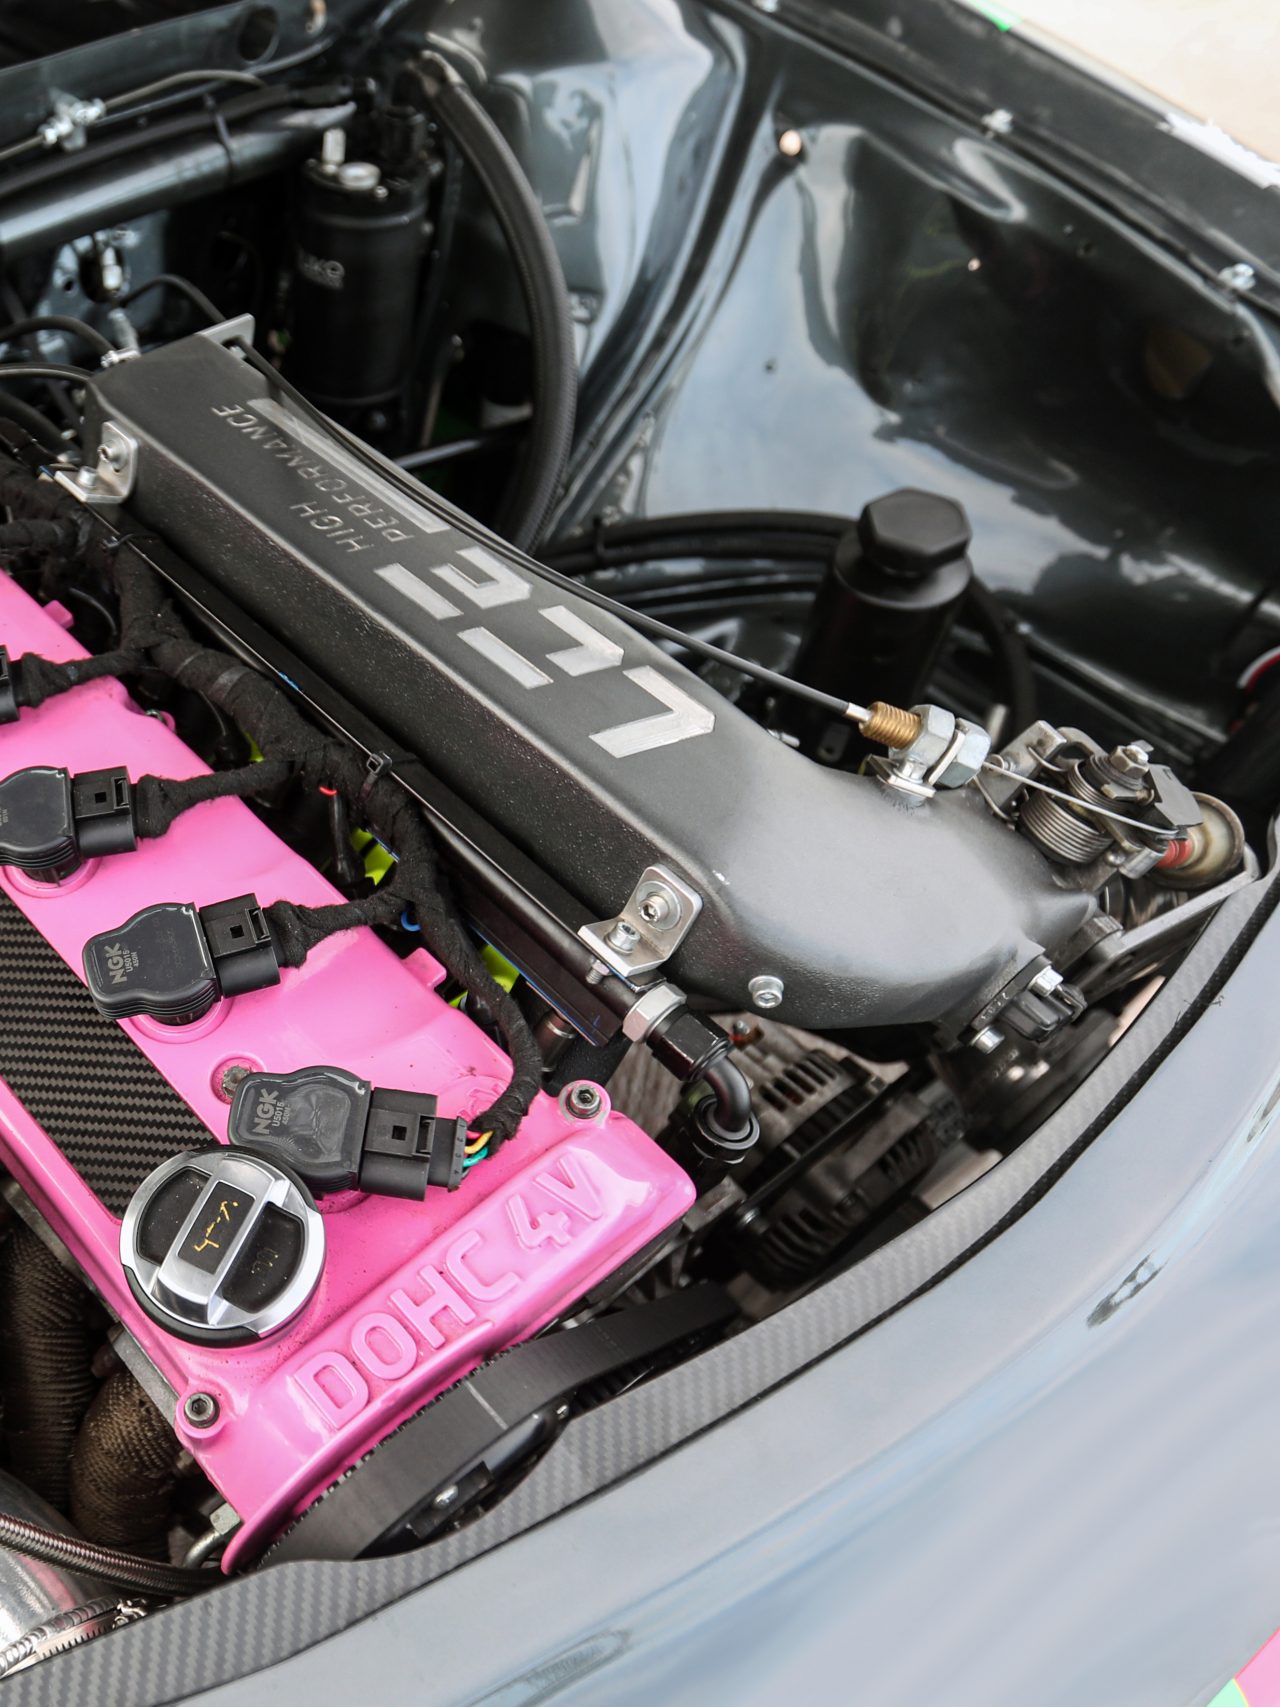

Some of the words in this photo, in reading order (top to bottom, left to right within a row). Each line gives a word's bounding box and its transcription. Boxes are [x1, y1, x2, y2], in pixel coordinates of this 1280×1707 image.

[210, 403, 415, 543] PERFORMANCE
[289, 501, 374, 553] HIGH
[103, 943, 128, 985] NGK
[122, 950, 134, 973] U5015
[252, 1088, 280, 1135] NGK
[272, 1101, 285, 1127] U5015
[286, 1229, 521, 1431] DOHC
[505, 1155, 604, 1249] 4V
